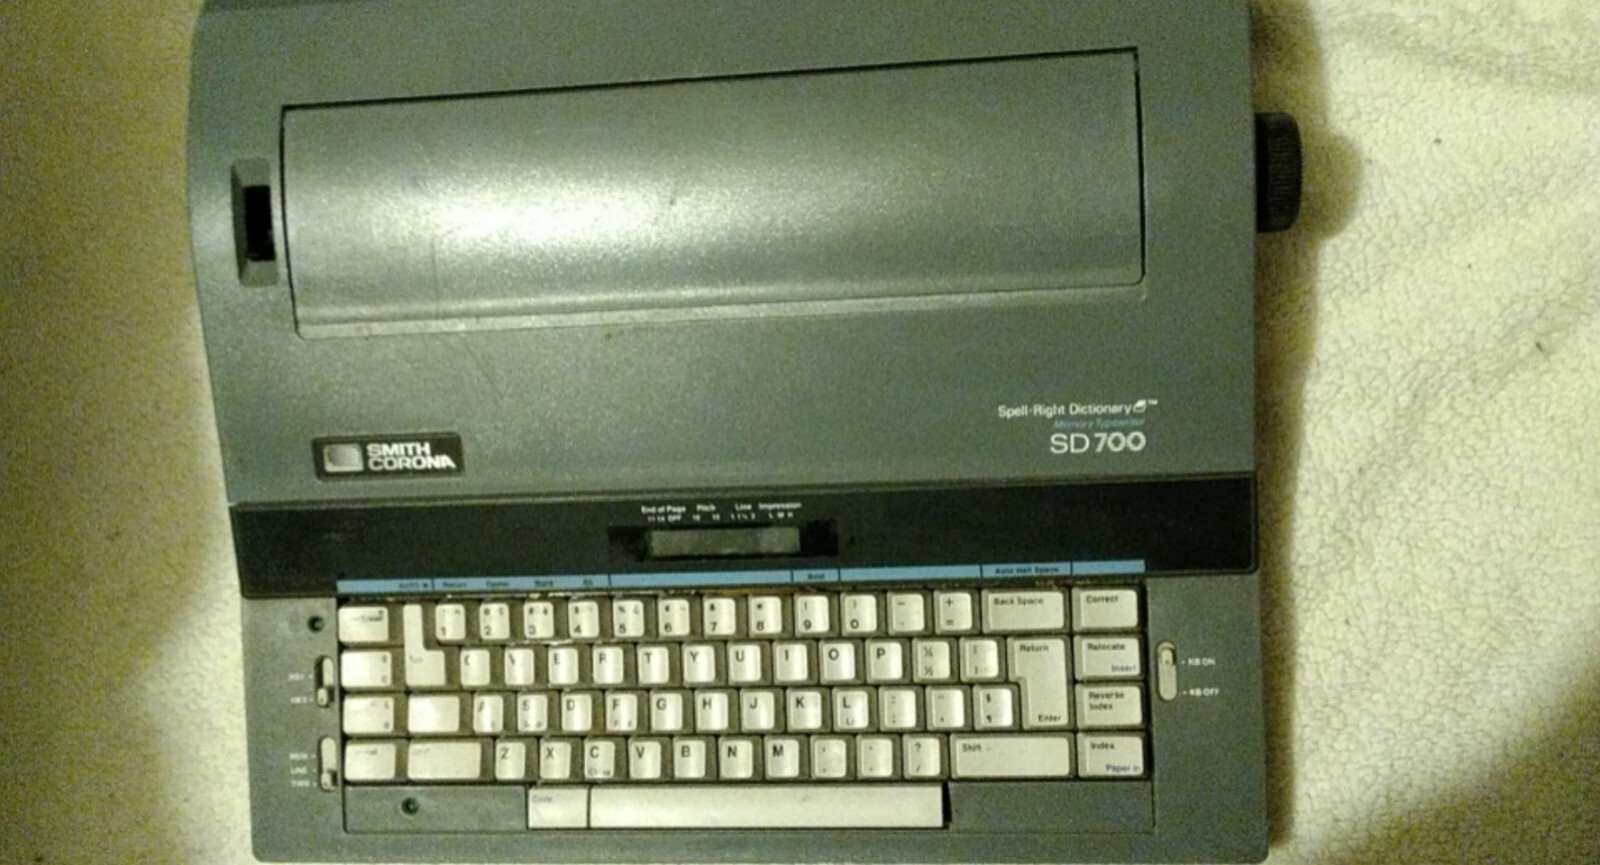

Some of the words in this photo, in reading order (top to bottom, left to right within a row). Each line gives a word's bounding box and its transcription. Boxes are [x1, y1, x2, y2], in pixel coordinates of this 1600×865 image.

[1069, 402, 1132, 415] Dictionary
[1050, 433, 1090, 454] SD
[1094, 431, 1146, 452] 700
[366, 442, 431, 457] SMITH
[368, 454, 457, 471] CORONA
[641, 505, 656, 514] End
[666, 505, 686, 514] Page
[696, 504, 716, 512] Pitch
[735, 503, 752, 511] Line
[758, 502, 802, 512] Impression
[994, 598, 1014, 606] Back
[1018, 598, 1043, 606] Space
[1086, 595, 1119, 603] Correct
[528, 625, 536, 635] 3
[574, 625, 582, 634] 4
[618, 624, 626, 634] 5
[664, 621, 672, 632] 6
[709, 621, 718, 632] 7
[756, 620, 764, 631] 8
[803, 620, 812, 630] 9
[484, 626, 492, 636] 2
[1020, 644, 1049, 653] Return
[1087, 642, 1125, 651] Relocate
[553, 653, 561, 665] E
[644, 652, 653, 663] T
[690, 651, 699, 662] Y
[736, 651, 745, 662] U
[828, 649, 839, 661] O
[876, 648, 886, 660] P
[1188, 658, 1200, 666] KB
[1202, 658, 1216, 666] ON
[1111, 664, 1136, 672] Insert
[1088, 691, 1124, 700] Reverse
[1203, 688, 1219, 696] OFF
[566, 699, 575, 711] D
[612, 699, 620, 710] F
[656, 698, 667, 711] G
[703, 698, 712, 709] H
[750, 698, 758, 709] J
[796, 697, 805, 708] K
[843, 697, 851, 708] L
[1090, 702, 1113, 710] Index
[1038, 714, 1061, 723] Enter
[773, 745, 784, 757] M
[915, 743, 922, 752] ?
[962, 743, 983, 752] Shift
[1090, 741, 1114, 750] Index
[501, 748, 509, 759] Z
[545, 747, 555, 758] X
[589, 746, 599, 758] C
[635, 747, 644, 758] V
[681, 746, 690, 758] B
[727, 746, 737, 757] N
[1106, 764, 1131, 773] Paper
